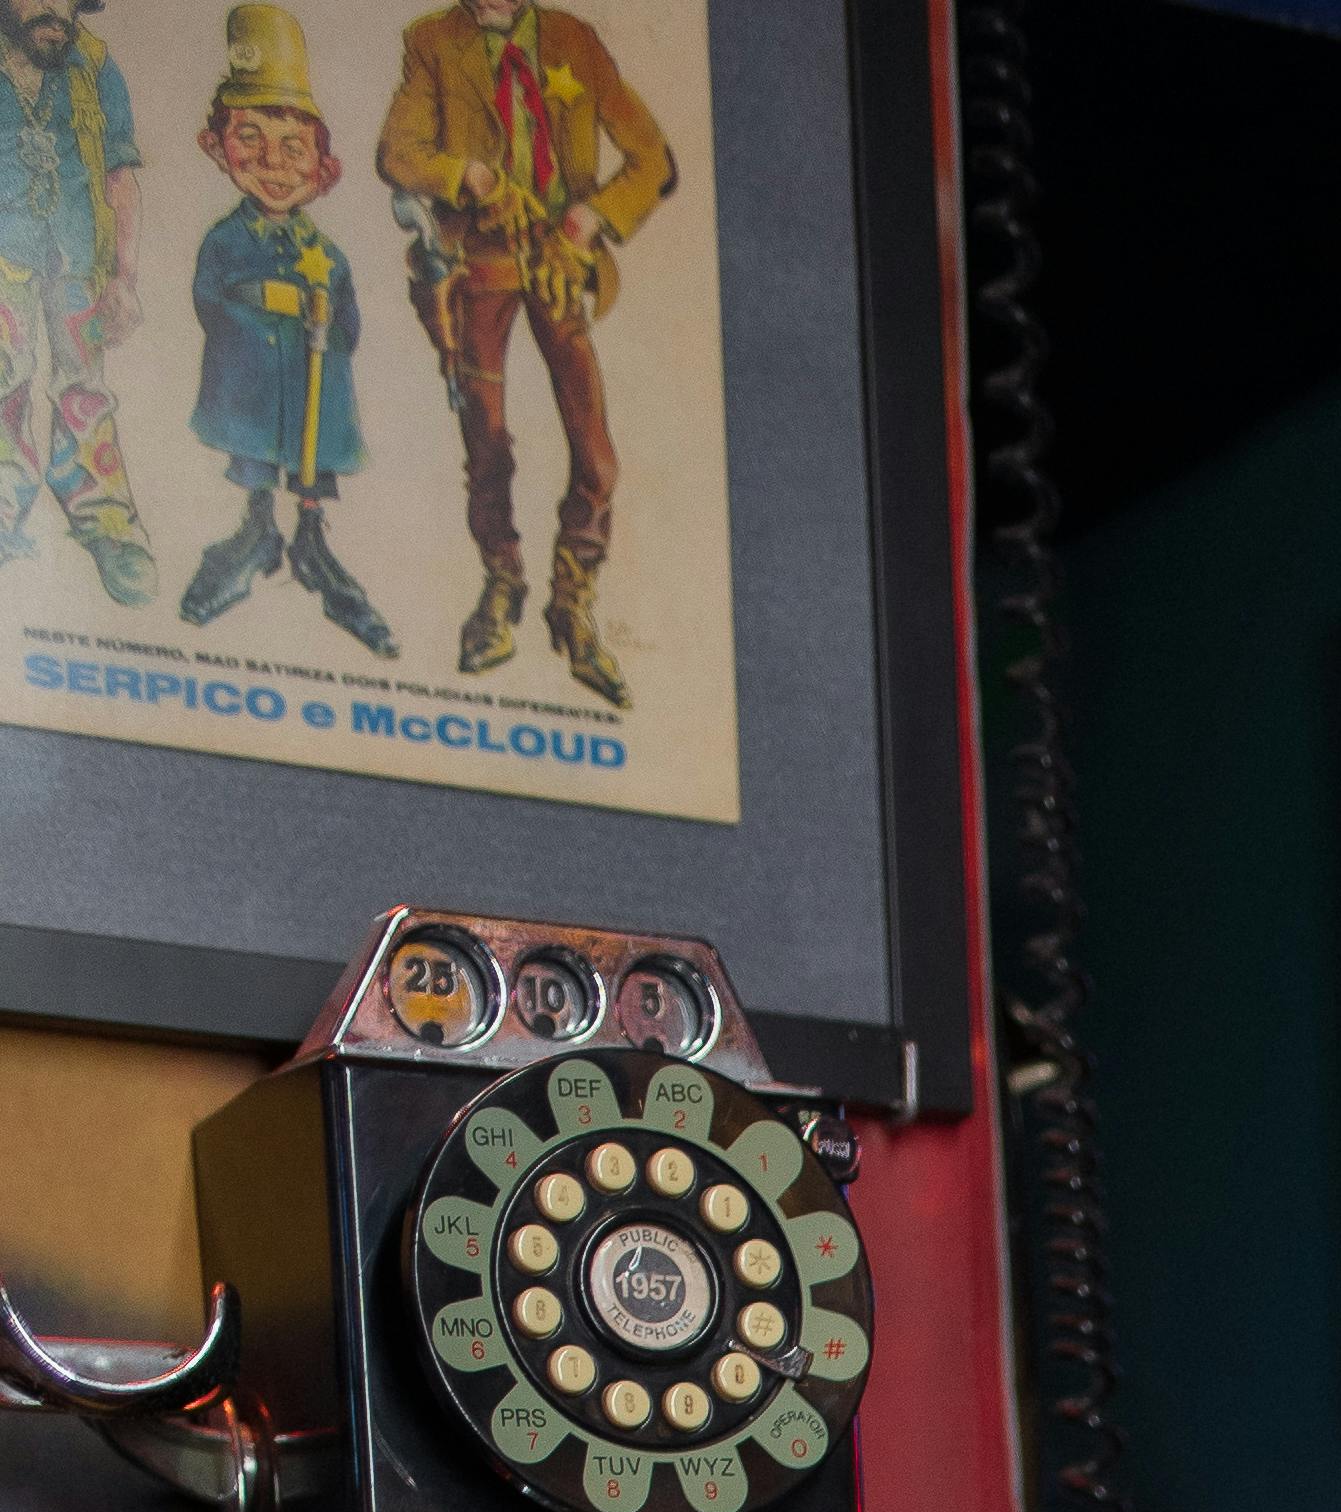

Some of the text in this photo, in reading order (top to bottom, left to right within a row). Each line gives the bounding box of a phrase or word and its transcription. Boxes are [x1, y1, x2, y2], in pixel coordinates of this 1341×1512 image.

[23, 651, 628, 770] SERPICO e McCLOUD
[402, 956, 459, 996] 25
[520, 974, 565, 1014] 10
[641, 981, 665, 1018] 5
[557, 1078, 602, 1098] DEF
[655, 1084, 703, 1104] ABC
[578, 1104, 592, 1125] 3
[673, 1110, 686, 1130] 2
[472, 1127, 513, 1147] GHI
[505, 1151, 518, 1169] 4
[609, 1156, 621, 1177] 3
[759, 1153, 769, 1173] 1
[667, 1160, 679, 1182] 2
[558, 1185, 570, 1207] 4
[434, 1216, 479, 1236] JKL
[466, 1238, 480, 1258] 5
[619, 1229, 679, 1252] PUBLIC
[615, 1270, 682, 1300] 1957
[441, 1318, 493, 1338] MNO
[607, 1309, 696, 1340] TELEPHONE
[471, 1340, 485, 1360] 6
[823, 1338, 847, 1360] #
[567, 1355, 581, 1378] 7
[684, 1394, 694, 1416] 9
[501, 1408, 546, 1428] PRS
[769, 1410, 825, 1439] OPERATOR
[527, 1431, 539, 1451] 7
[593, 1456, 641, 1476] TUV
[680, 1458, 735, 1477] WYZ
[607, 1479, 621, 1499] 8
[704, 1481, 718, 1501] 9
